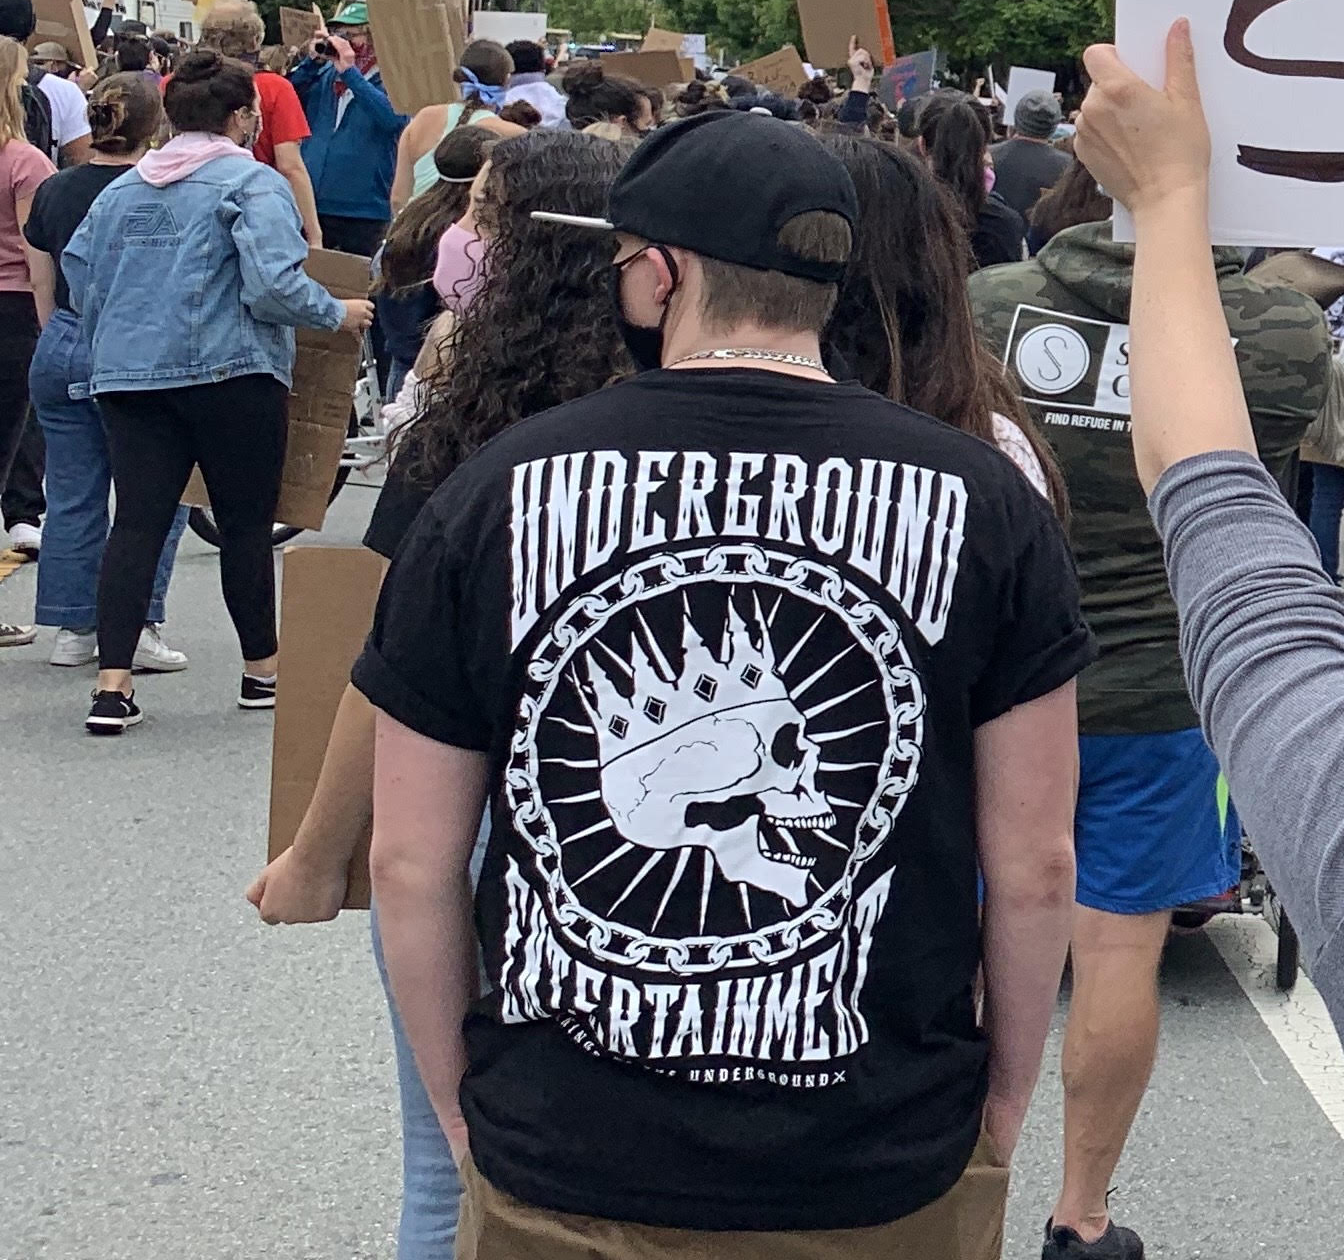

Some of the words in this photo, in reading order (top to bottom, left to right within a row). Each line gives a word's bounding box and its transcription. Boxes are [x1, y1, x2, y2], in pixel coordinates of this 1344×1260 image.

[1044, 412, 1070, 427] FIND
[1070, 414, 1113, 430] REFUGE
[1112, 420, 1126, 432] IN
[508, 450, 969, 655] UNDERGROUND
[689, 1067, 829, 1088] UNDERGROUND
